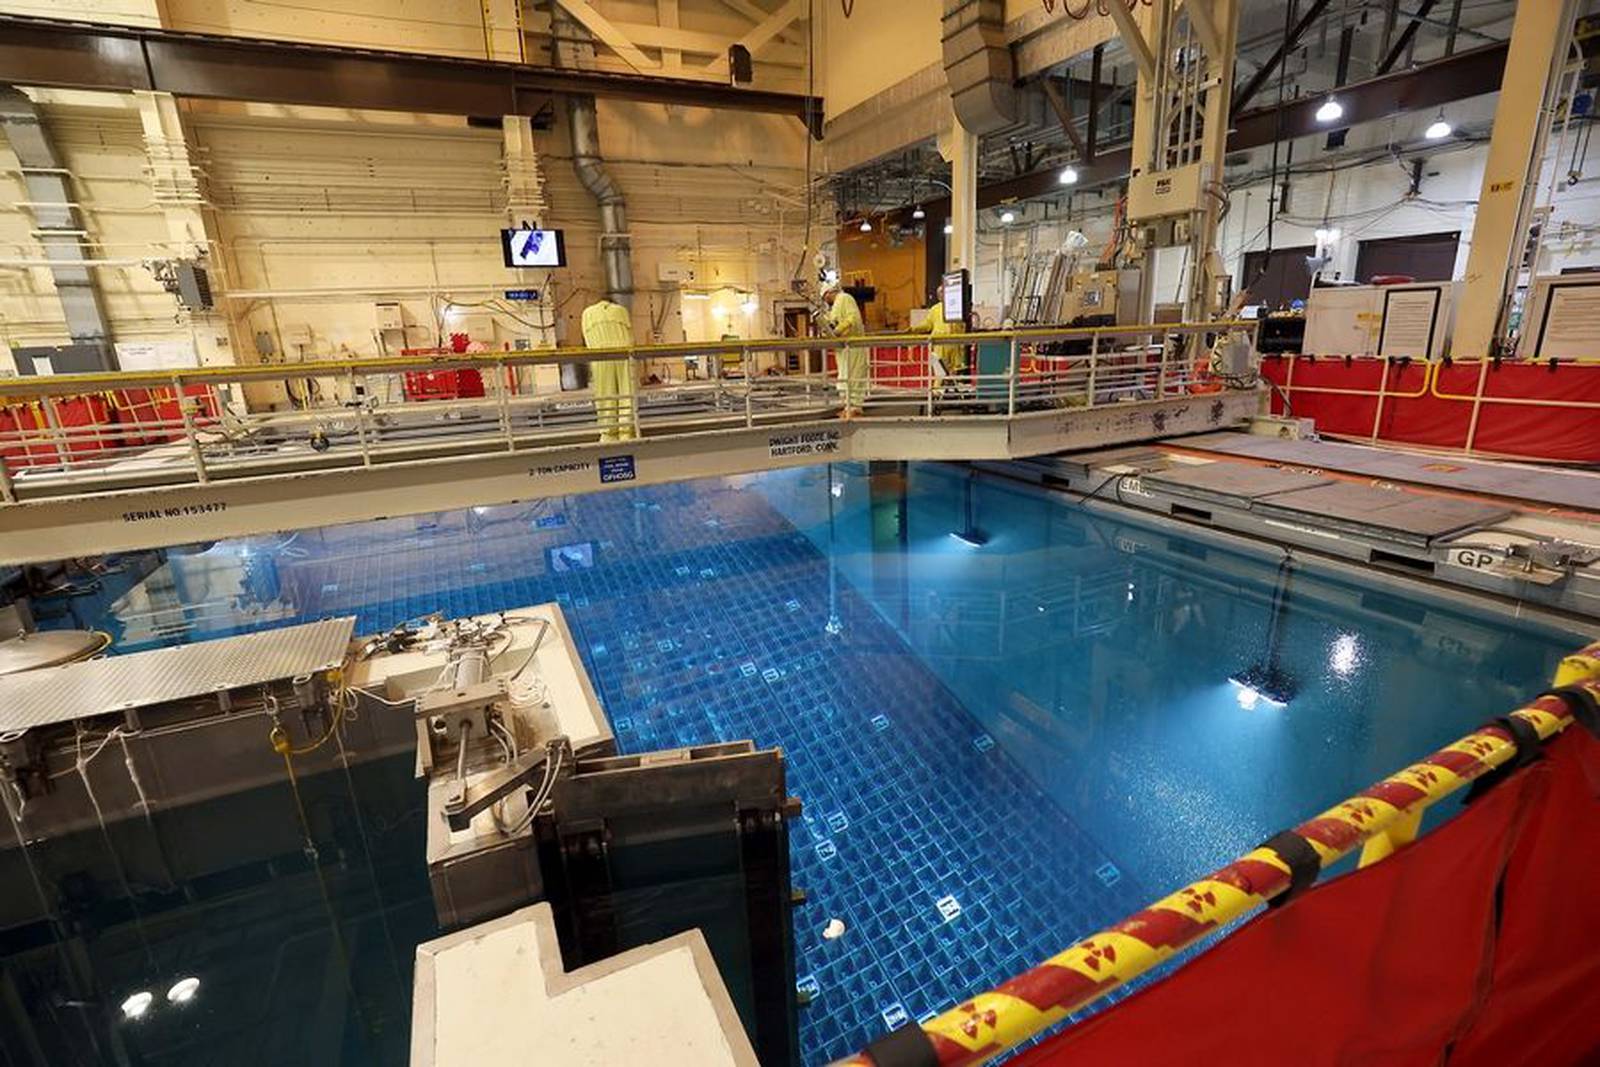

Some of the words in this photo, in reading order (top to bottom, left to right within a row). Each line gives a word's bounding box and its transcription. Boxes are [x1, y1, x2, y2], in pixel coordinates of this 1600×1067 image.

[770, 443, 812, 456] HARTFORD
[537, 467, 552, 475] TON
[554, 462, 590, 473] CAPACITY
[122, 510, 162, 522] SERIAL
[183, 502, 227, 516] 153477
[1457, 550, 1494, 568] GP
